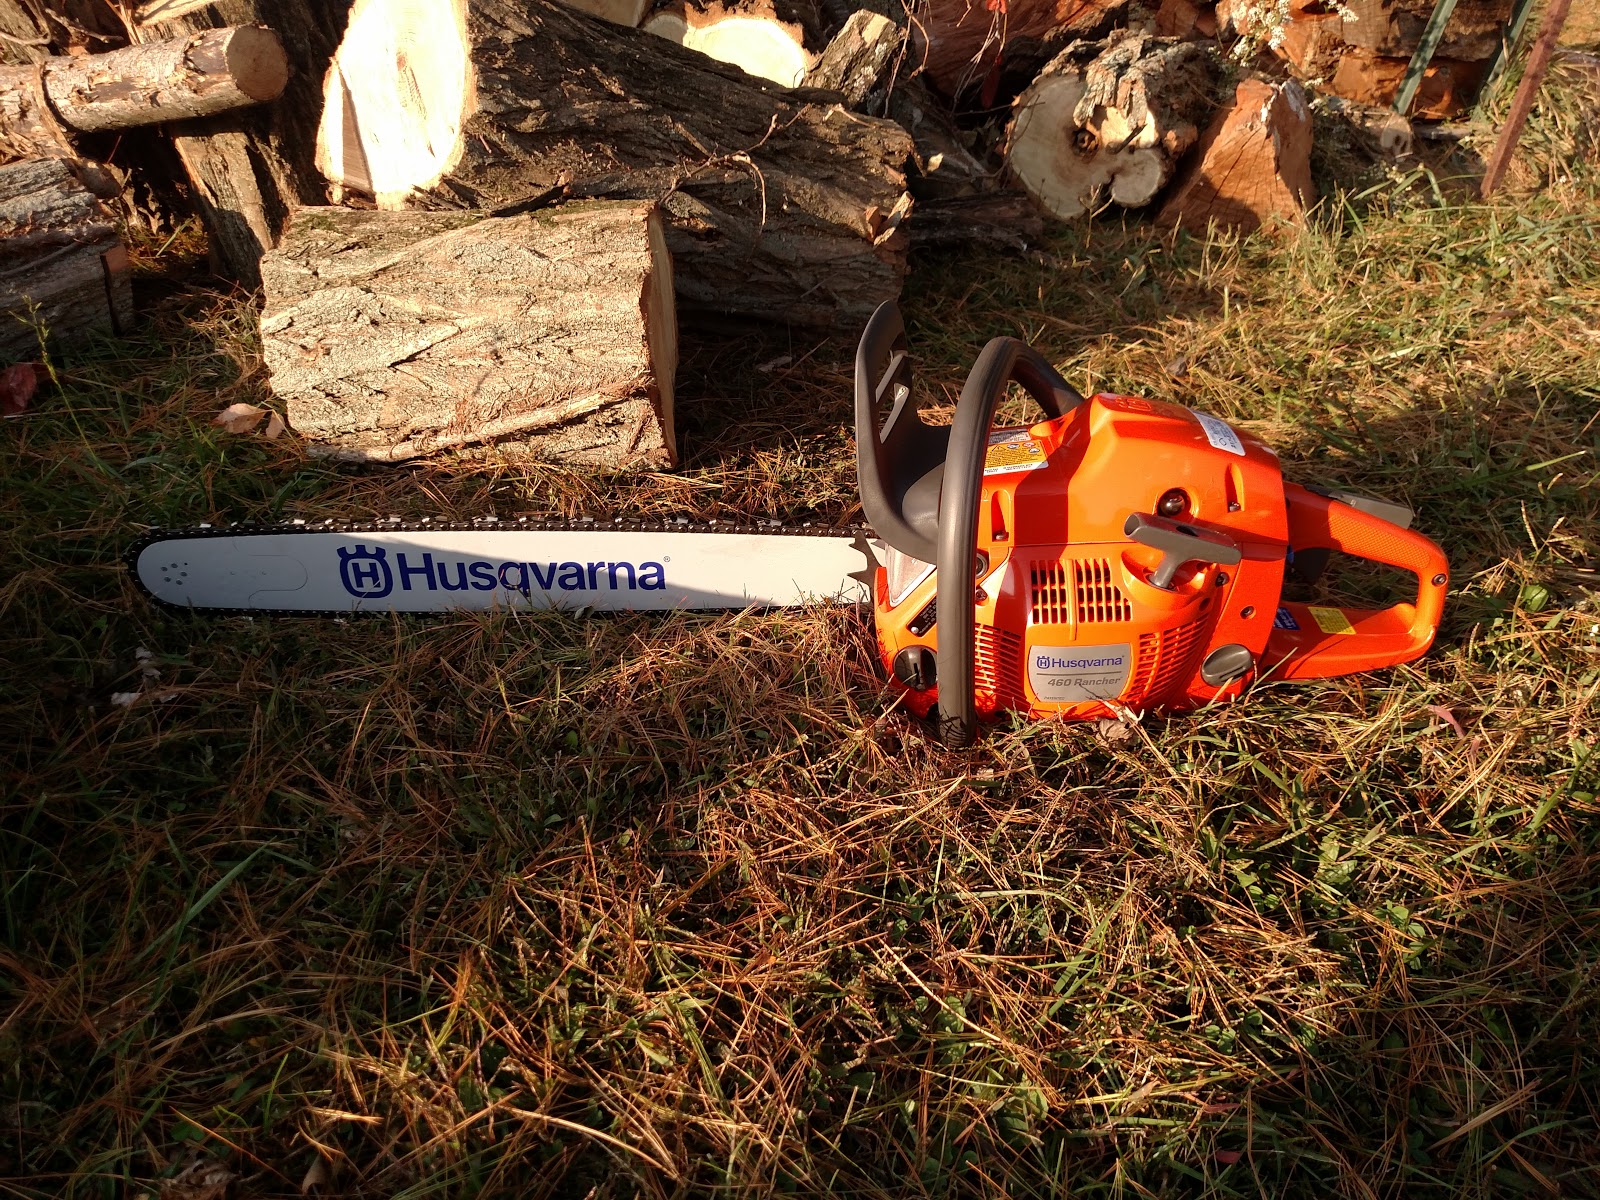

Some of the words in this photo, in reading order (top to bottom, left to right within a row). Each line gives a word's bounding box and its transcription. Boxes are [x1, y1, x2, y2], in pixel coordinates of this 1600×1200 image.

[396, 552, 667, 598] Husqvarna
[1051, 657, 1123, 669] Husqvarna
[1047, 678, 1072, 687] 460
[1074, 677, 1121, 686] Rancher
